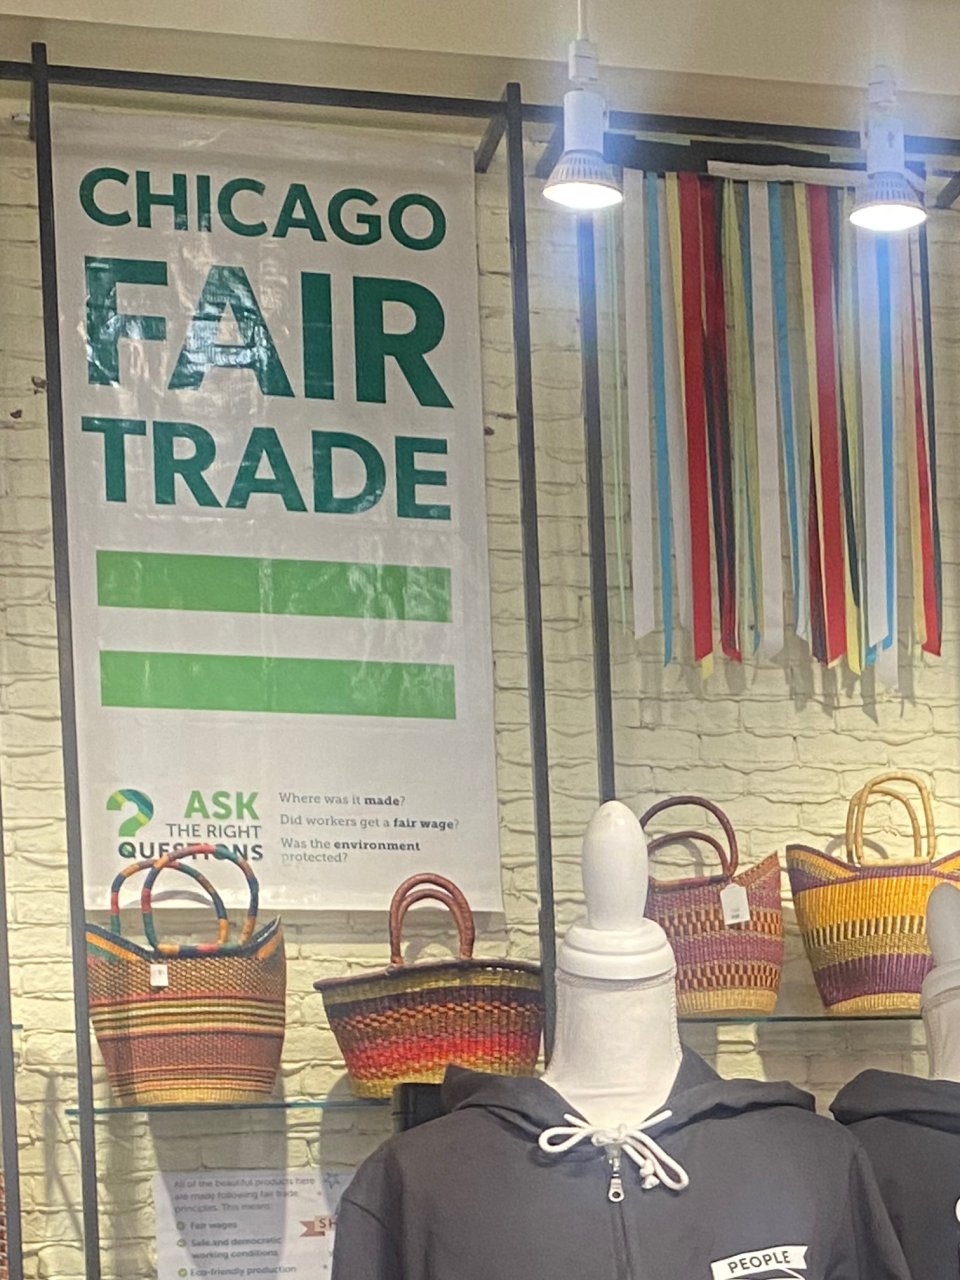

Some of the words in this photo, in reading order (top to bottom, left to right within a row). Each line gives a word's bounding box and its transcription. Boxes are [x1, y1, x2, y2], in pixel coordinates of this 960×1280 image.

[79, 167, 447, 251] CHICAGO
[84, 256, 454, 409] FAIR
[81, 416, 452, 520] TRADE
[184, 790, 260, 820] ASK
[279, 792, 321, 805] Where
[324, 795, 349, 805] was
[352, 793, 361, 805] it
[364, 795, 405, 806] made?
[165, 823, 201, 838] THE
[207, 824, 262, 839] RIGHT
[280, 814, 302, 826] Did
[306, 815, 357, 827] workers
[360, 818, 379, 829] get
[383, 820, 390, 828] a
[393, 817, 417, 828] fair
[420, 820, 460, 831] wage?
[118, 841, 263, 861] QUESTNS
[280, 837, 306, 849] Was
[310, 838, 331, 849] the
[334, 840, 421, 851] environment
[281, 852, 348, 865] protected?
[727, 1250, 791, 1274] PEOPLE
